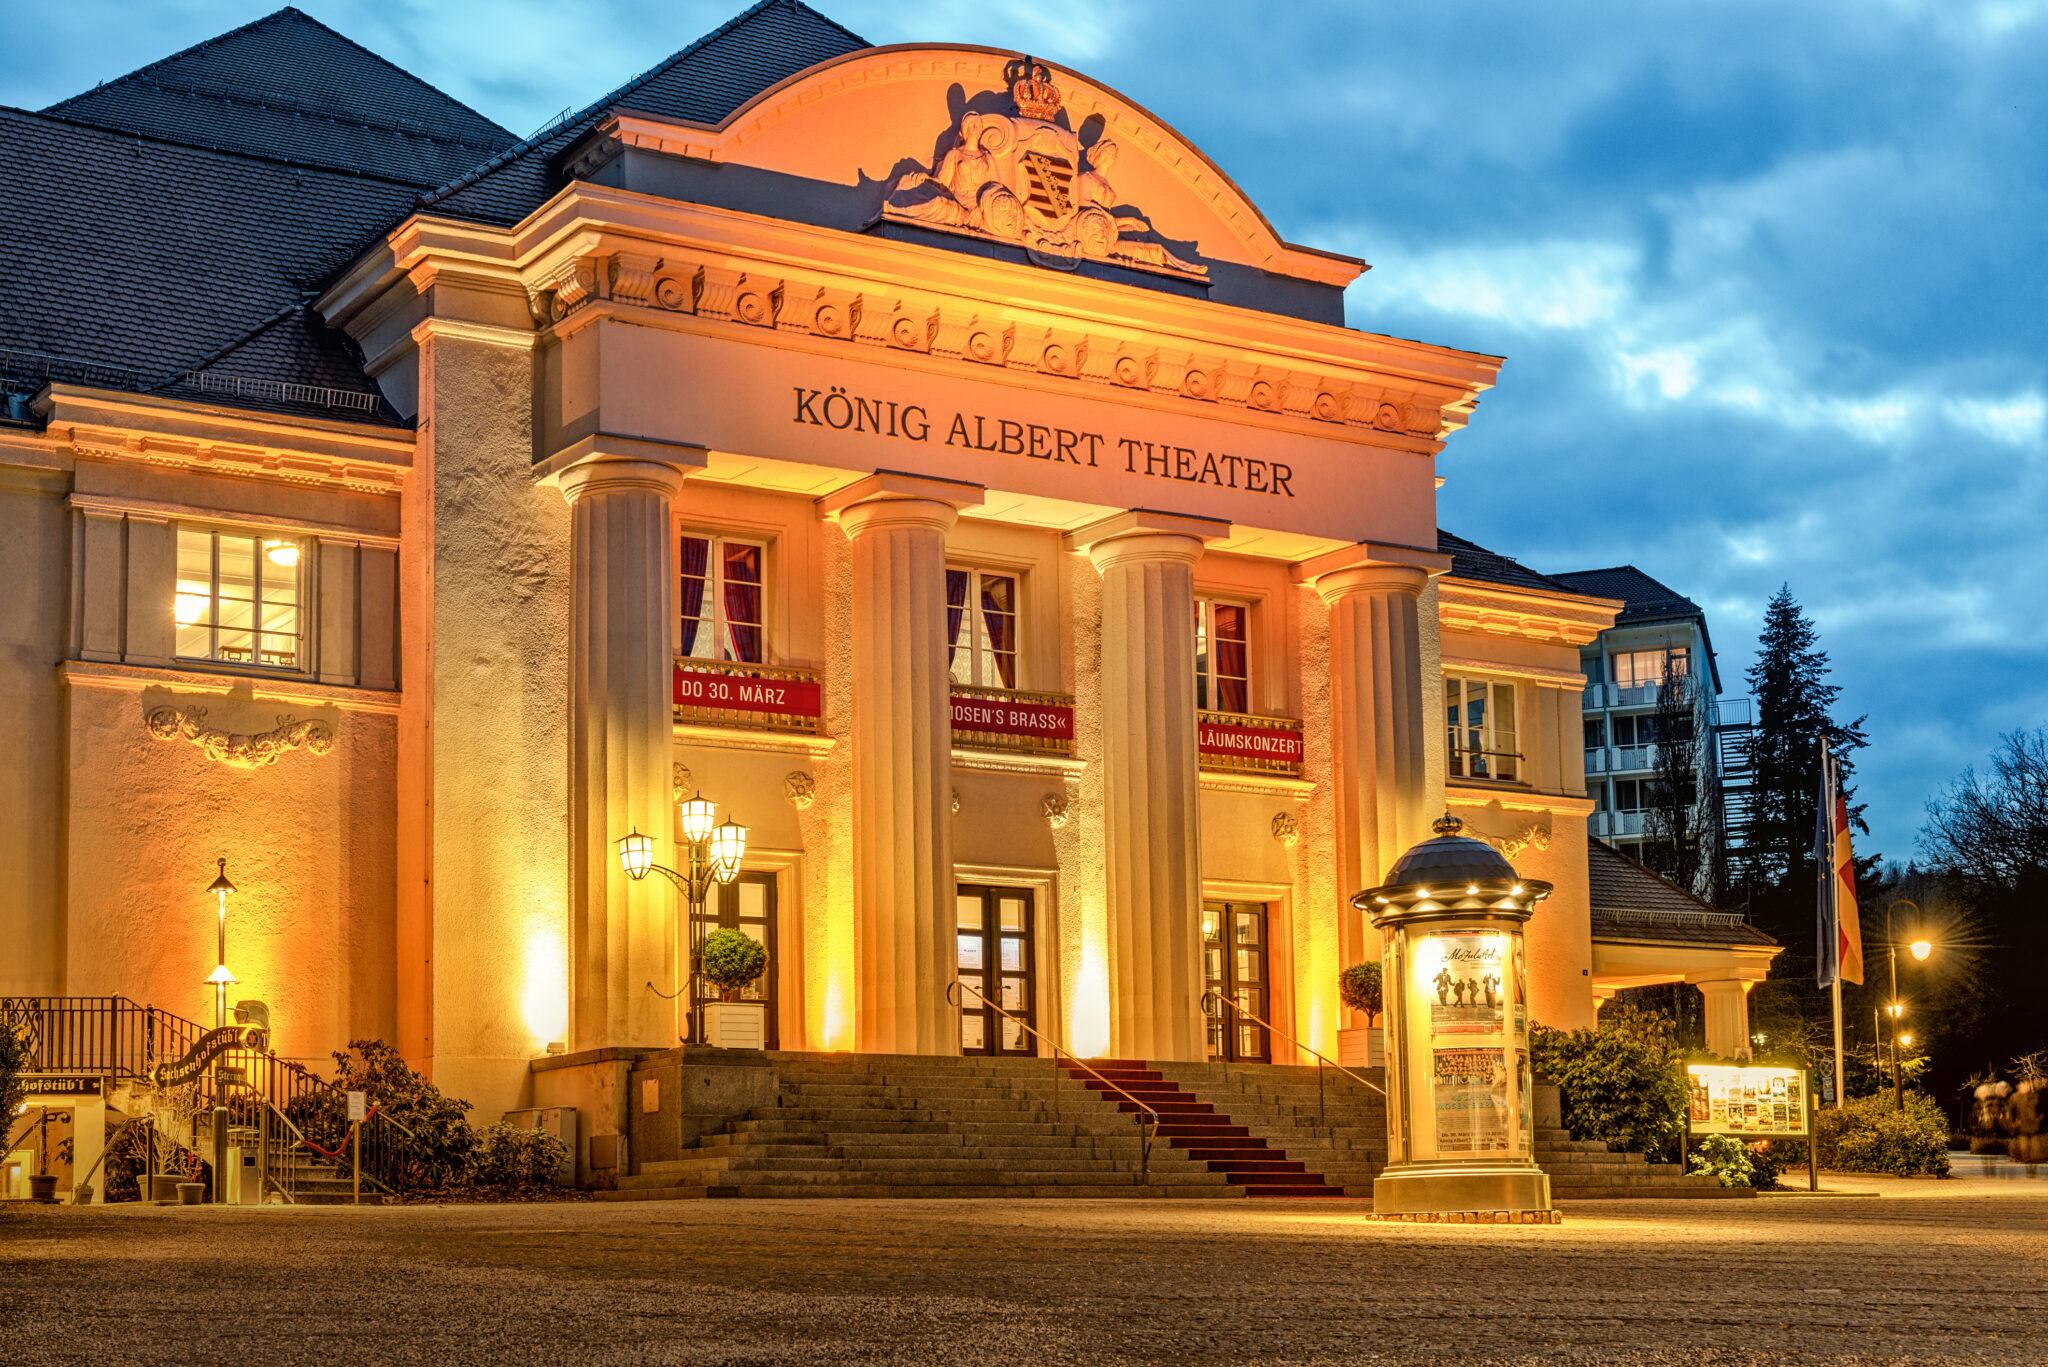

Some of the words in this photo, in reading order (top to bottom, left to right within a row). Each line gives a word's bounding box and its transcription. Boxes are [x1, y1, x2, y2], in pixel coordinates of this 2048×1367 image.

[793, 386, 931, 443] KÖNIG
[944, 412, 1105, 467] ALBERT
[1117, 437, 1296, 497] THEATER
[682, 680, 703, 697] DO
[708, 682, 734, 701] 30.
[739, 684, 785, 705] MÄRZ
